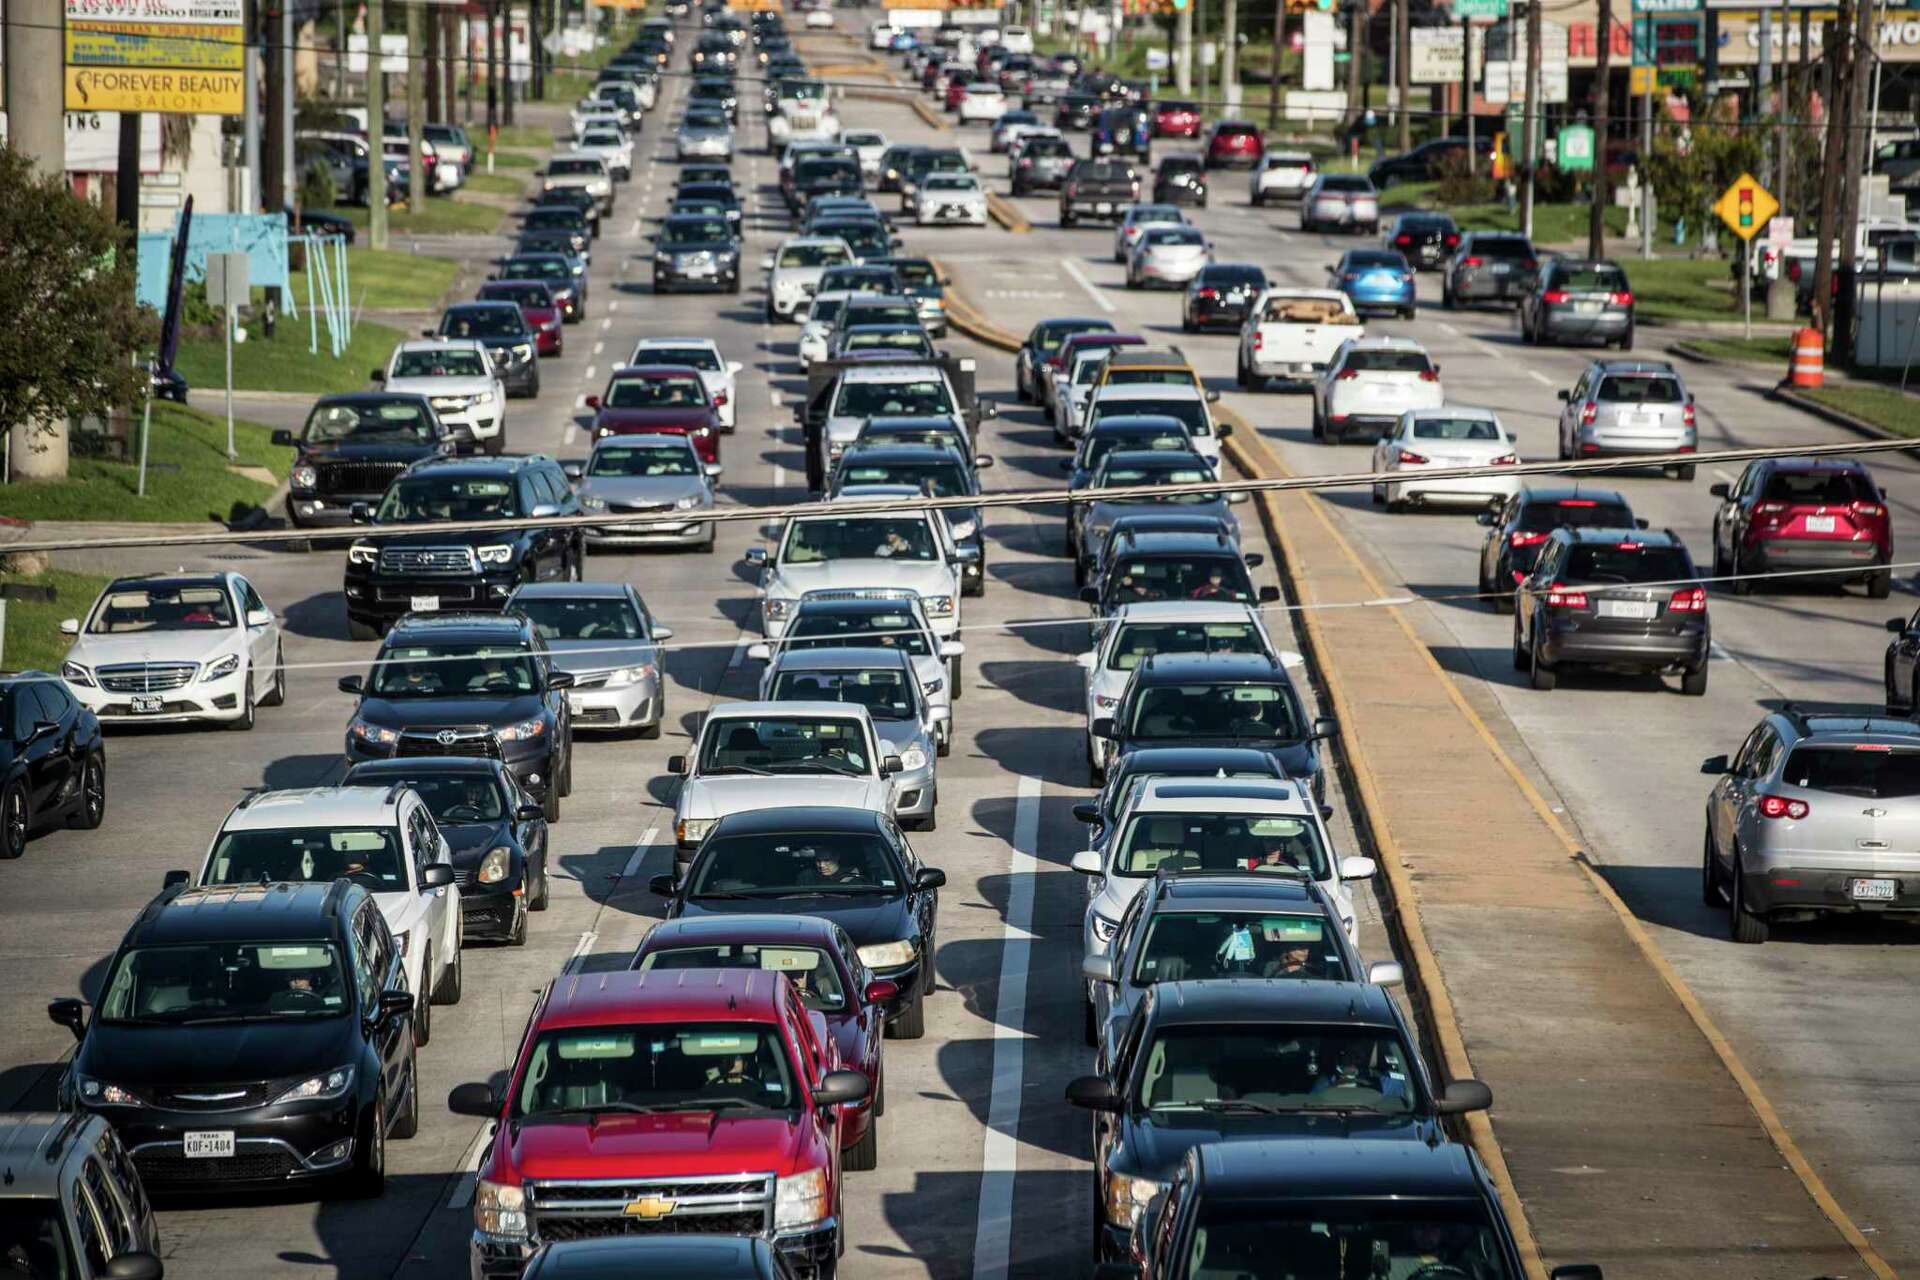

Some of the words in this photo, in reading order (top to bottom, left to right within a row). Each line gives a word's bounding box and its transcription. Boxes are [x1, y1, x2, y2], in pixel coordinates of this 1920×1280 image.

[93, 72, 173, 91] FOREVER
[180, 75, 241, 93] BEAUTY
[133, 96, 201, 108] SALON
